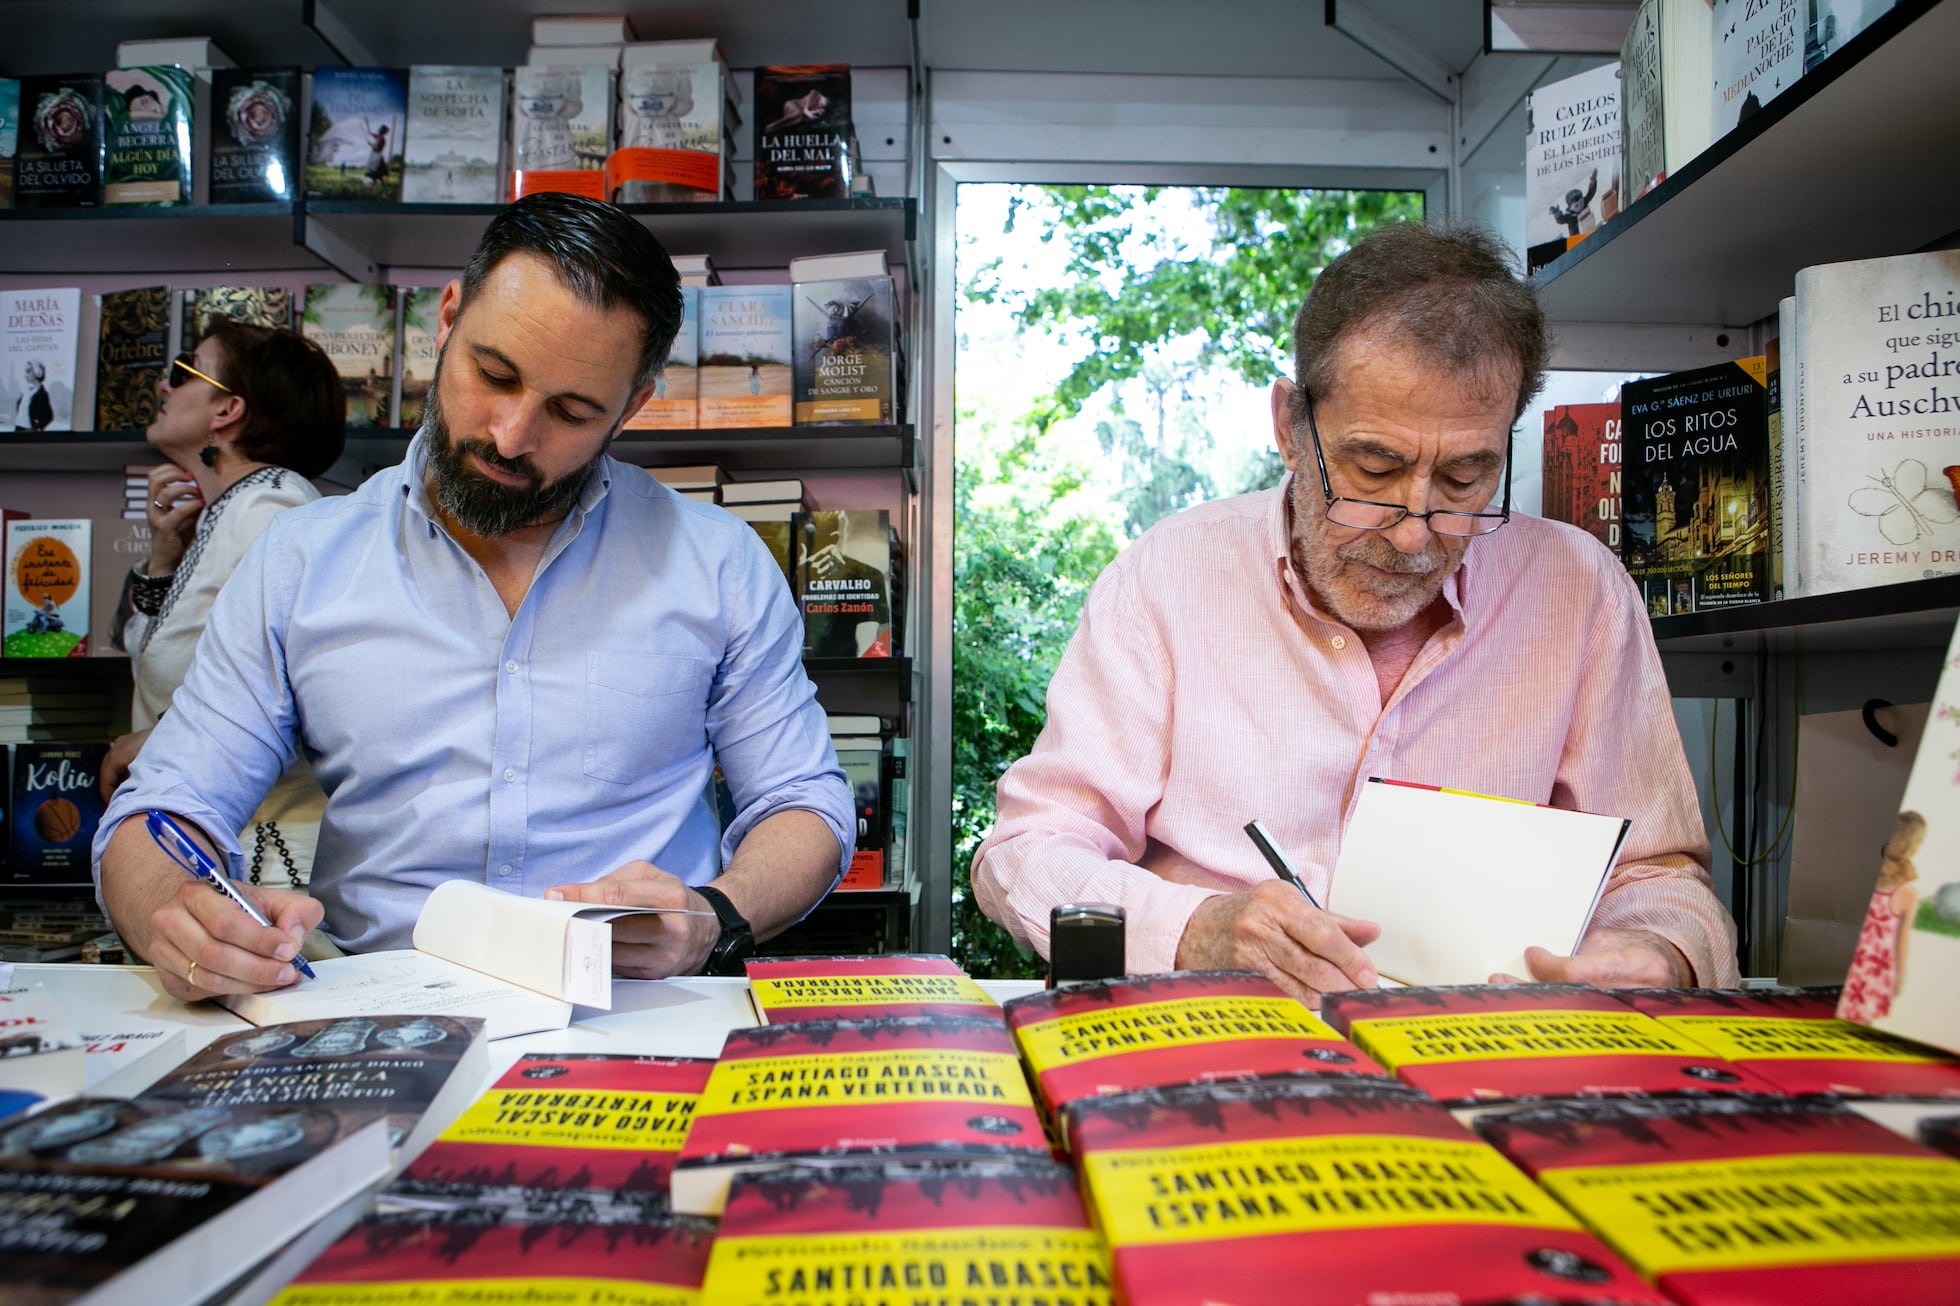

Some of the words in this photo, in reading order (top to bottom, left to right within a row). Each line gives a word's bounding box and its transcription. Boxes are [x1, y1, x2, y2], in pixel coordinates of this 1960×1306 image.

[1746, 8, 1796, 54] PALACIO
[1760, 38, 1777, 59] DE
[1778, 26, 1795, 47] LA
[1722, 41, 1794, 104] MEDIANOCHE
[447, 80, 464, 90] LA
[420, 93, 489, 105] SOSPECHA
[1556, 92, 1616, 121] CARLOS
[423, 106, 439, 117] DE
[1539, 122, 1576, 145] RUIZ
[1581, 105, 1621, 131] ZAFÓ
[118, 134, 176, 148] BECERRA
[762, 136, 780, 149] LA
[784, 133, 842, 147] HUELLA
[1543, 148, 1559, 161] EL
[1561, 130, 1622, 155] LABERINT
[111, 149, 153, 163] ALGÚN
[213, 155, 228, 167] LA
[770, 148, 800, 162] DEL
[803, 148, 835, 161] MAL
[1536, 166, 1551, 177] DE
[1553, 158, 1574, 173] LOS
[1576, 144, 1622, 165] ESPÍRIT
[20, 162, 34, 173] LA
[38, 160, 84, 173] SILUETA
[132, 163, 158, 175] HOY
[213, 168, 235, 180] DEL
[19, 175, 41, 186] DEL
[44, 173, 91, 185] OLVIDO
[15, 294, 60, 313] MARÍA
[717, 300, 768, 313] CLARA
[8, 312, 64, 328] DUEÑAS
[1878, 304, 1901, 323] El
[1886, 335, 1921, 354] que
[821, 354, 863, 367] JORGE
[819, 364, 867, 376] MOLIST
[1843, 374, 1853, 384] a
[1858, 371, 1880, 384] su
[824, 376, 861, 386] CANCIÓN
[820, 386, 851, 394] SANGRE
[860, 385, 879, 393] ORO
[1632, 404, 1649, 415] EVA
[1667, 393, 1699, 409] SÁENZ
[1702, 391, 1715, 402] DE
[1718, 384, 1753, 399] URTURI
[1645, 418, 1676, 440] LOS
[1685, 408, 1738, 433] RITOS
[1867, 431, 1895, 441] UNA
[1645, 443, 1674, 463] DEL
[1682, 433, 1738, 457] AGUA
[1774, 440, 1783, 499] SIERRA
[1773, 501, 1784, 555] JAVIER
[1846, 551, 1921, 566] JEREMY
[1705, 573, 1719, 582] LOS
[1721, 571, 1754, 581] SEÑORES
[809, 579, 871, 591] CARVALHO
[1709, 581, 1722, 590] DEL
[1723, 580, 1750, 589] TIEMPO
[846, 592, 880, 600] IDENTIDAD
[806, 602, 839, 614] Carlos
[841, 601, 874, 613] Zanón
[26, 759, 95, 792] Kolia
[771, 979, 885, 989] VERTEBRADA
[871, 987, 961, 997] SANTIAGO
[784, 988, 864, 998] ABASCAL
[1060, 1012, 1176, 1042] SANTIAGO
[1186, 1007, 1289, 1025] ABASCAL
[1164, 1021, 1317, 1041] VERTEBRADA
[1404, 1023, 1532, 1042] SANTIAGO
[1537, 1022, 1652, 1038] ABASCAL
[1515, 1036, 1685, 1053] VERTEBRADA
[747, 1066, 870, 1086] SANTIAGO
[880, 1063, 990, 1081] ABASCAL
[730, 1082, 830, 1106] ESPAÑA
[843, 1080, 1006, 1100] VERTEBRADA
[499, 1093, 652, 1113] VERTEBRADA
[495, 1109, 608, 1131] ABASCAL
[615, 1115, 690, 1133] TIAGO
[1148, 1161, 1322, 1199] SANTIAGO
[1333, 1160, 1491, 1187] ABASCAL
[1146, 1192, 1292, 1231] ESPAÑA
[1299, 1188, 1540, 1219] VERTEBRADA
[763, 1262, 947, 1298] SANTIAGO
[965, 1261, 1110, 1291] ABASCA
